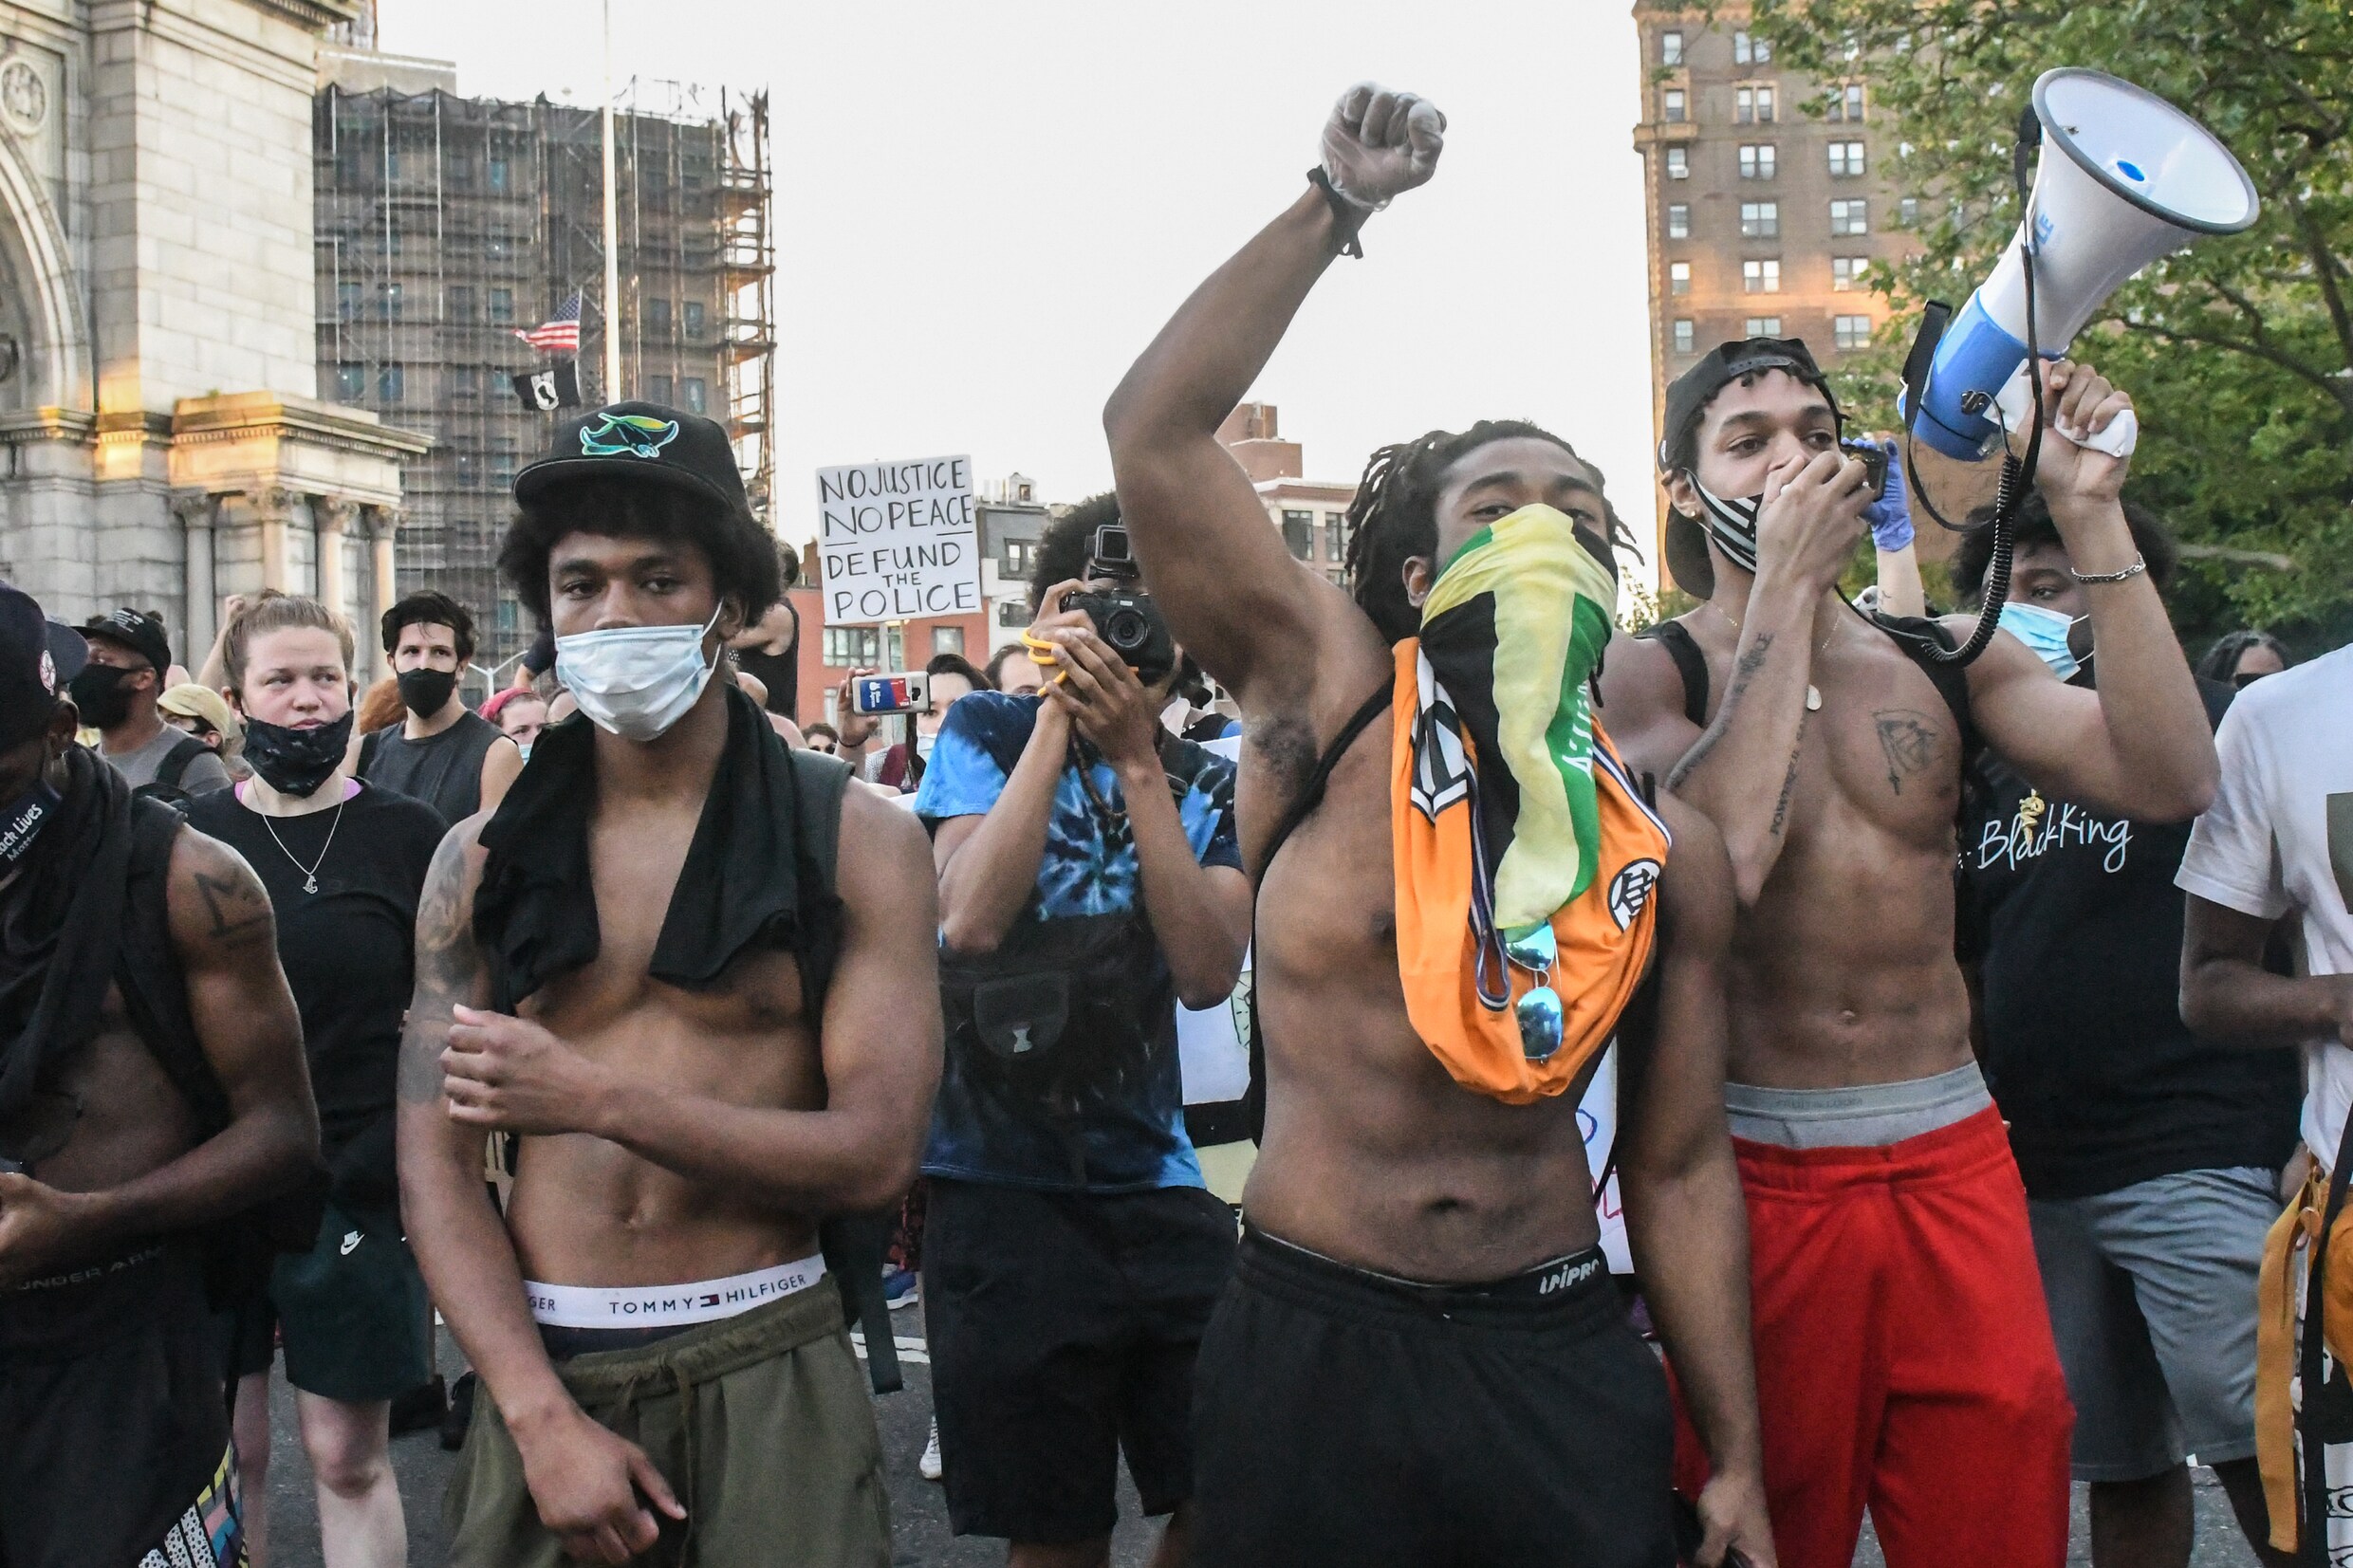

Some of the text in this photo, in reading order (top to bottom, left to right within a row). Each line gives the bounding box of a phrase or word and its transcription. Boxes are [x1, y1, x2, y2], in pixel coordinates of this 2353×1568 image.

[820, 460, 966, 504] NO JUSTICE
[824, 494, 973, 537] NO PEACE
[827, 542, 961, 580] DEFUND
[882, 572, 922, 588] THE
[835, 582, 976, 618] POLICE
[0, 803, 44, 855] ack Lives
[609, 1298, 694, 1315] TOMMY
[726, 1274, 806, 1304] HILFIGER
